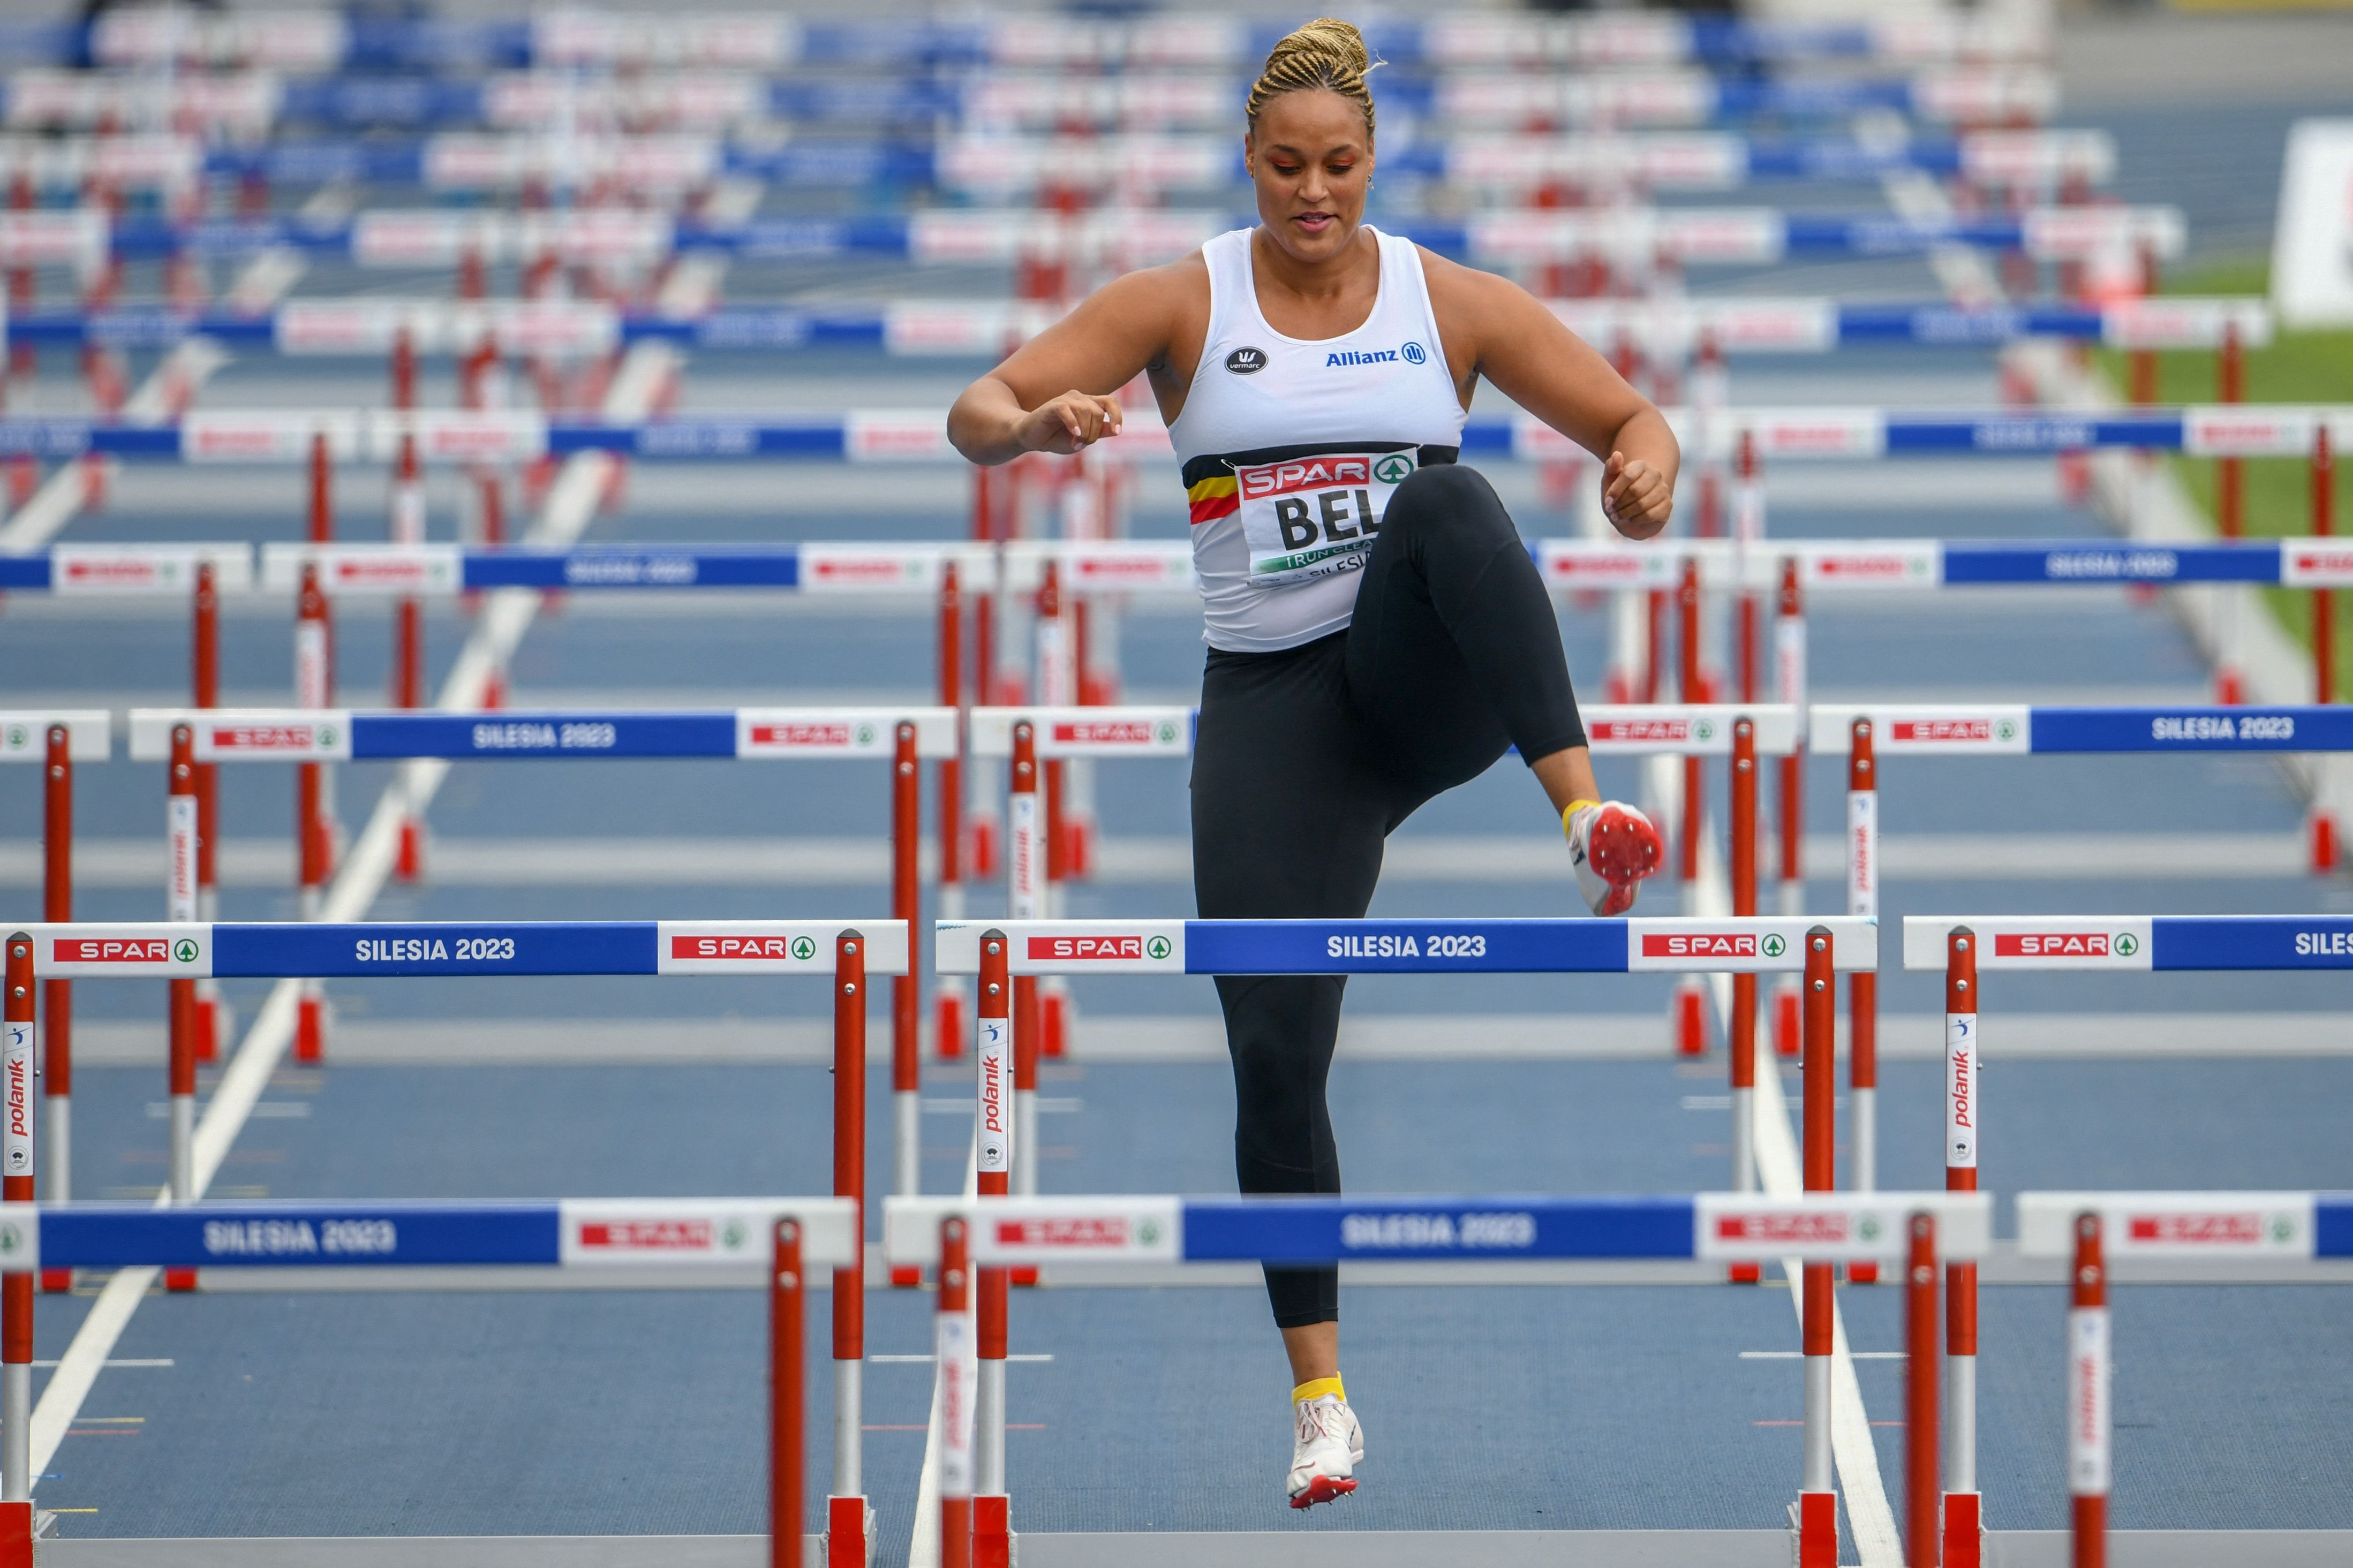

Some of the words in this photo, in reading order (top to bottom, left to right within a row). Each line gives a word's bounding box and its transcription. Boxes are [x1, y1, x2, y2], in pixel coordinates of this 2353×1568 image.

[1326, 350, 1399, 367] Allianz
[1244, 462, 1366, 494] SPAR
[1274, 489, 1383, 551] BEL
[1294, 550, 1329, 567] RUN
[1332, 540, 1372, 554] CLEA
[473, 724, 557, 749] SILESIA
[560, 723, 616, 748] 2023
[1610, 723, 1687, 740] SPAR
[1912, 722, 1989, 739] SPAR
[2152, 717, 2232, 740] SILESIA
[2239, 717, 2294, 739] 2023
[80, 942, 168, 959] SPAR
[355, 939, 448, 961] SILESIA
[455, 938, 515, 960] 2023
[698, 940, 785, 956] SPAR
[1053, 940, 1141, 956] SPAR
[1327, 935, 1420, 958] SILESIA
[1427, 935, 1487, 958] 2023
[1668, 937, 1755, 954] SPAR
[2020, 936, 2108, 953] SPAR
[7, 1057, 28, 1137] polanik
[982, 1054, 1003, 1133] polanik
[1951, 1049, 1972, 1128] polanik
[203, 1219, 316, 1256] SILESIA
[321, 1218, 397, 1254] 2023
